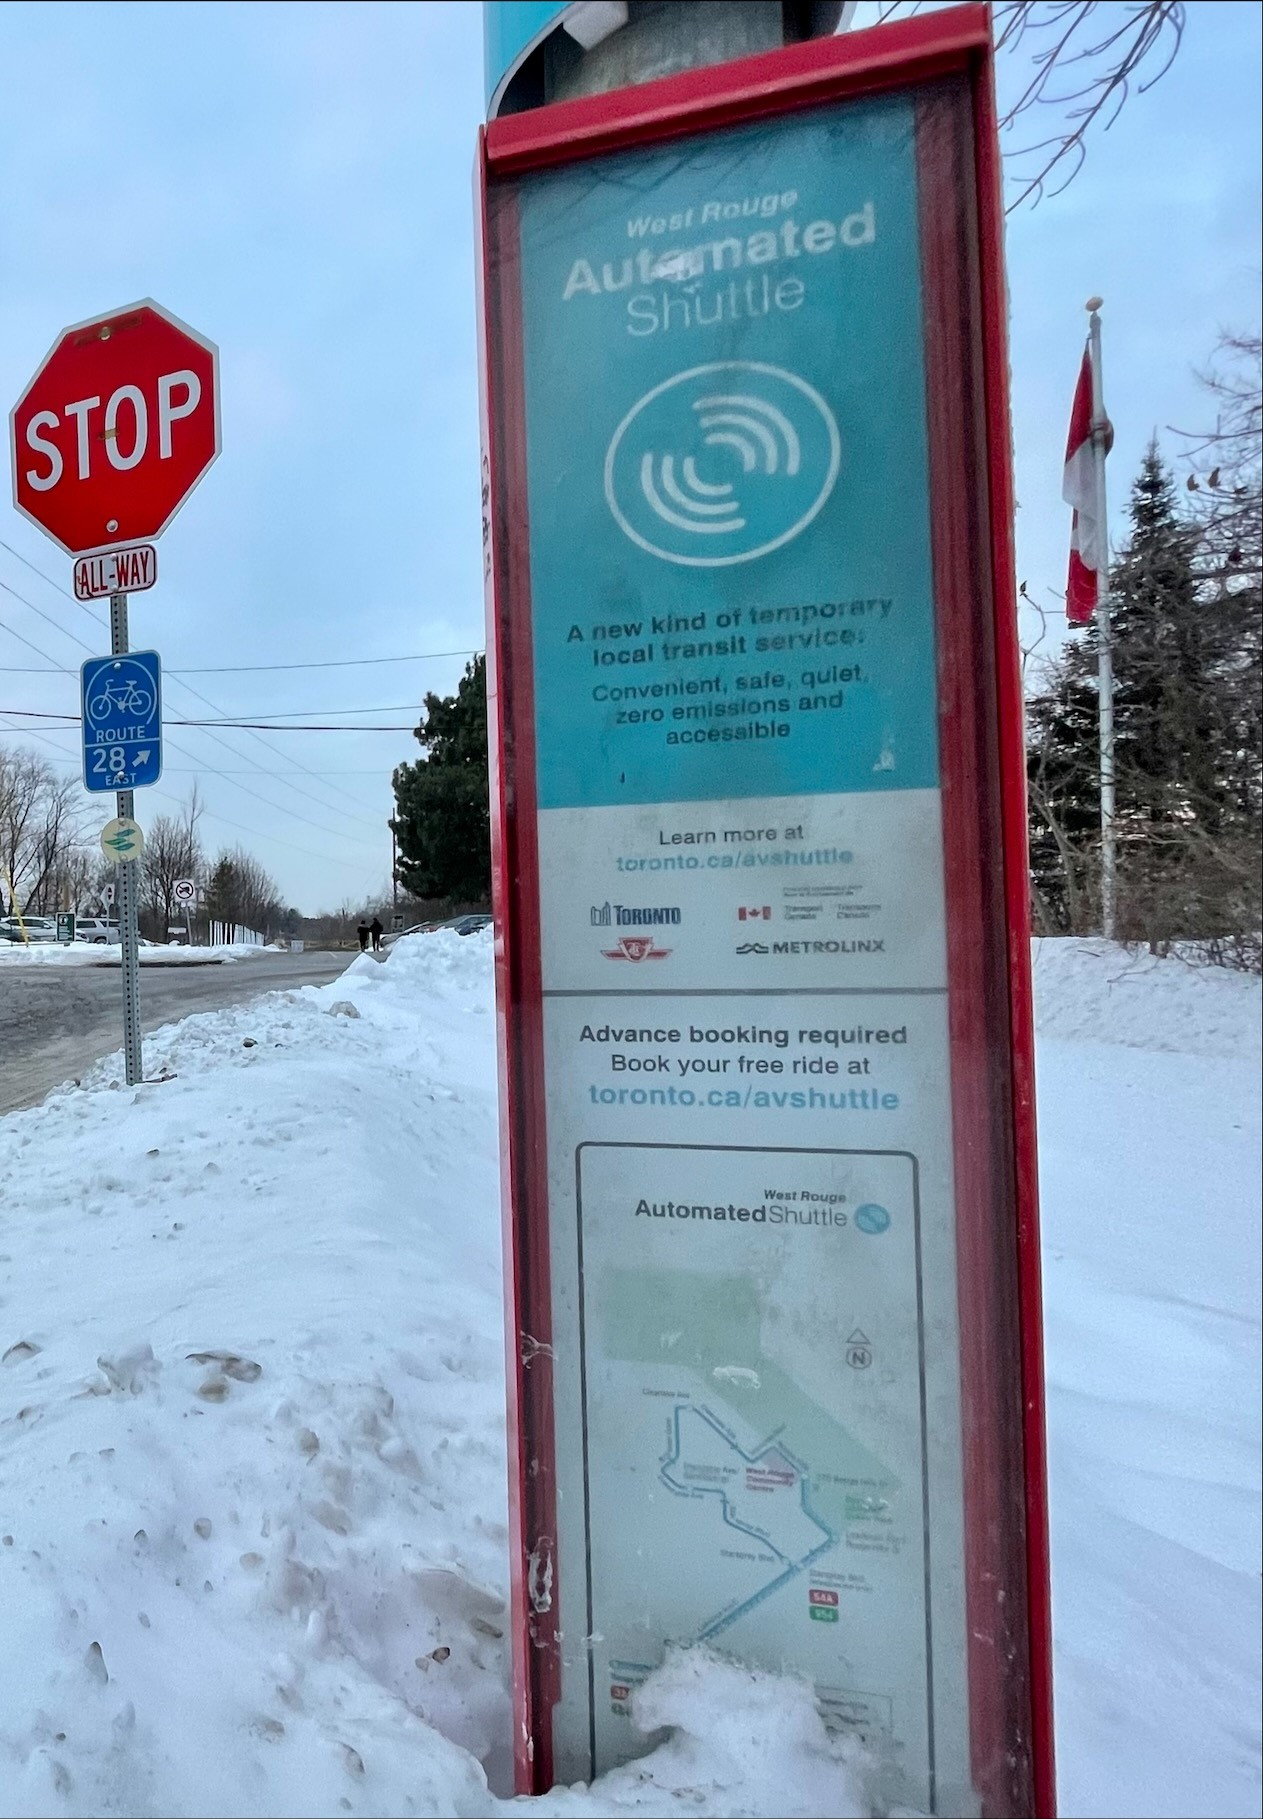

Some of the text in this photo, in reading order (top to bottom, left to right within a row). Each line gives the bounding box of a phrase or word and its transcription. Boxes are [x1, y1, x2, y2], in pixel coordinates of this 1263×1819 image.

[627, 189, 799, 239] West Rouge
[625, 274, 808, 338] Shuttle
[25, 369, 203, 492] STOP
[81, 551, 150, 595] ALL-WAY
[566, 597, 894, 643] A new kind of temporary
[593, 645, 654, 667] local
[662, 635, 746, 660] transit
[592, 677, 728, 703] Convenient,
[735, 671, 793, 692] safe,
[616, 691, 843, 725] zero emissions and
[95, 725, 147, 743] ROUTE
[666, 721, 791, 746] accessible
[93, 747, 127, 773] 28
[105, 771, 137, 786] EAST
[659, 825, 804, 846] Learn more at
[616, 847, 854, 873] toronto.ca/avshuttle
[773, 940, 886, 955] METROLINX
[579, 1025, 908, 1049] Advance booking required
[611, 1055, 871, 1078] Book your free ride at
[588, 1083, 900, 1111] toronto.ca/avshuttle
[764, 1189, 847, 1205] West Rouge
